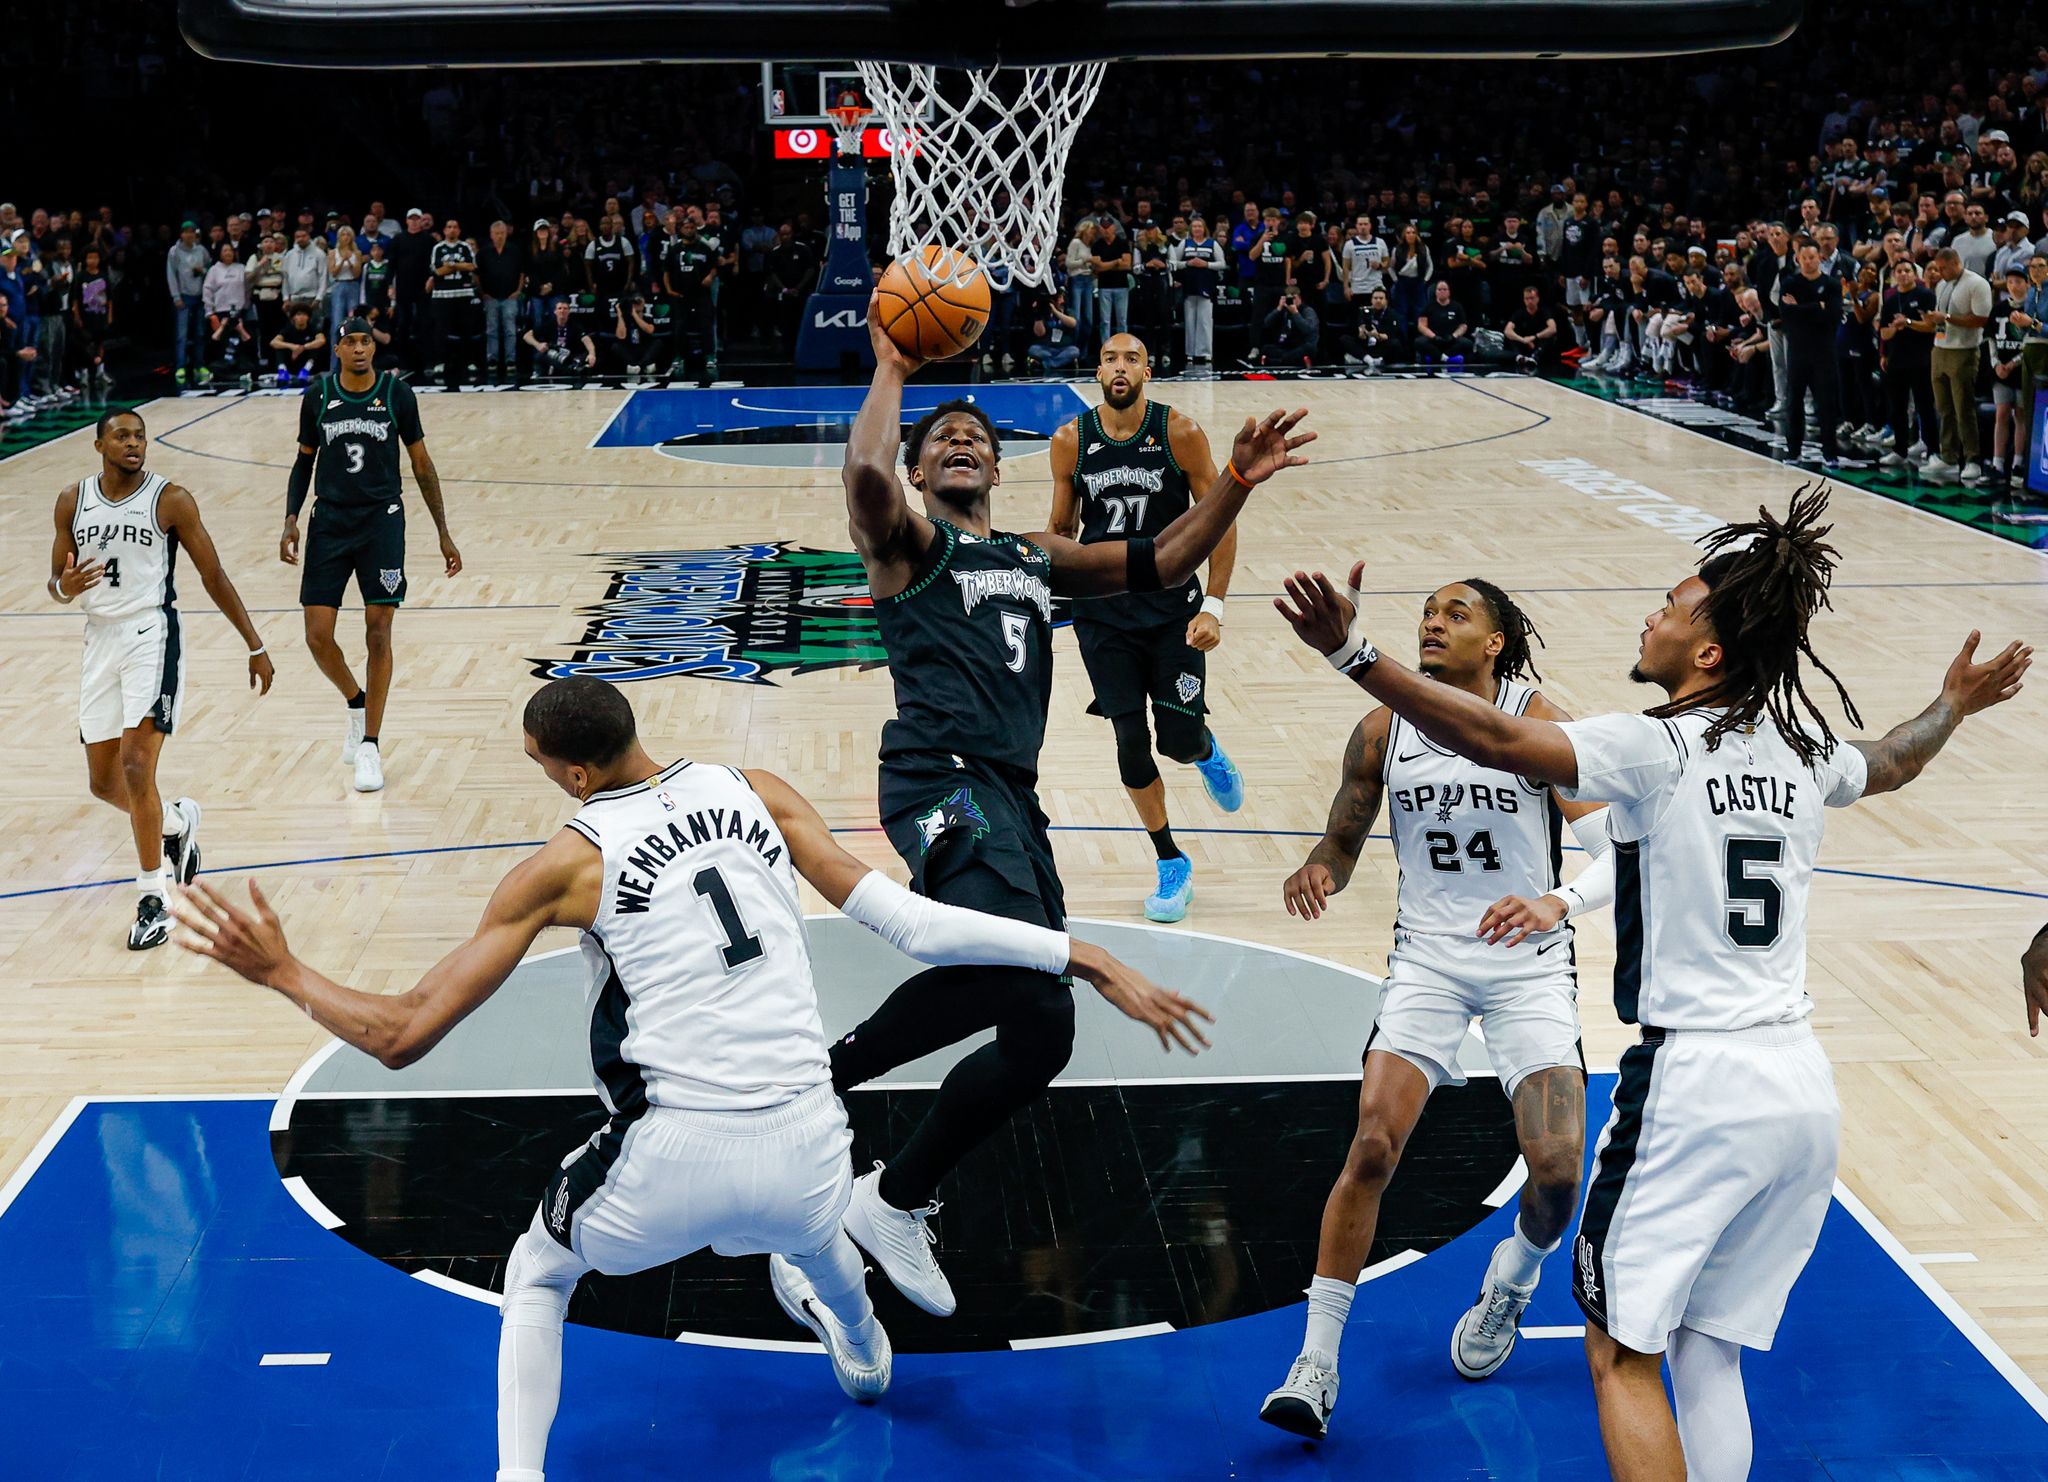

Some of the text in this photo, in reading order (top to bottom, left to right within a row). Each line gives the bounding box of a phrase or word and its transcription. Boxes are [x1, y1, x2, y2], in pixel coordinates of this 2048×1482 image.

[838, 193, 856, 208] GET
[839, 208, 857, 223] THE
[844, 224, 862, 242] App
[833, 276, 863, 287] Google
[179, 380, 745, 398] TIMRWOLVES
[321, 418, 391, 446] TIMBERWOLVES
[1138, 444, 1162, 453] sezzle
[344, 442, 365, 474] 3
[1081, 465, 1166, 502] TIMBERWOLVES
[1100, 494, 1149, 534] 27
[1518, 457, 1757, 556] TARGET CEN
[76, 524, 153, 551] SPURS
[103, 557, 120, 588] 4
[1021, 554, 1043, 563] zzle
[538, 542, 785, 684] TIMBERWOLVES
[949, 567, 1051, 624] TIMBERWOLVES
[1000, 610, 1030, 673] 5
[1395, 784, 1519, 824] SPURS
[1706, 774, 1797, 820] CASTLE
[615, 808, 782, 914] WEMBANYAMA
[1424, 828, 1504, 874] 24
[1723, 834, 1786, 952] 5
[688, 861, 768, 975] 1
